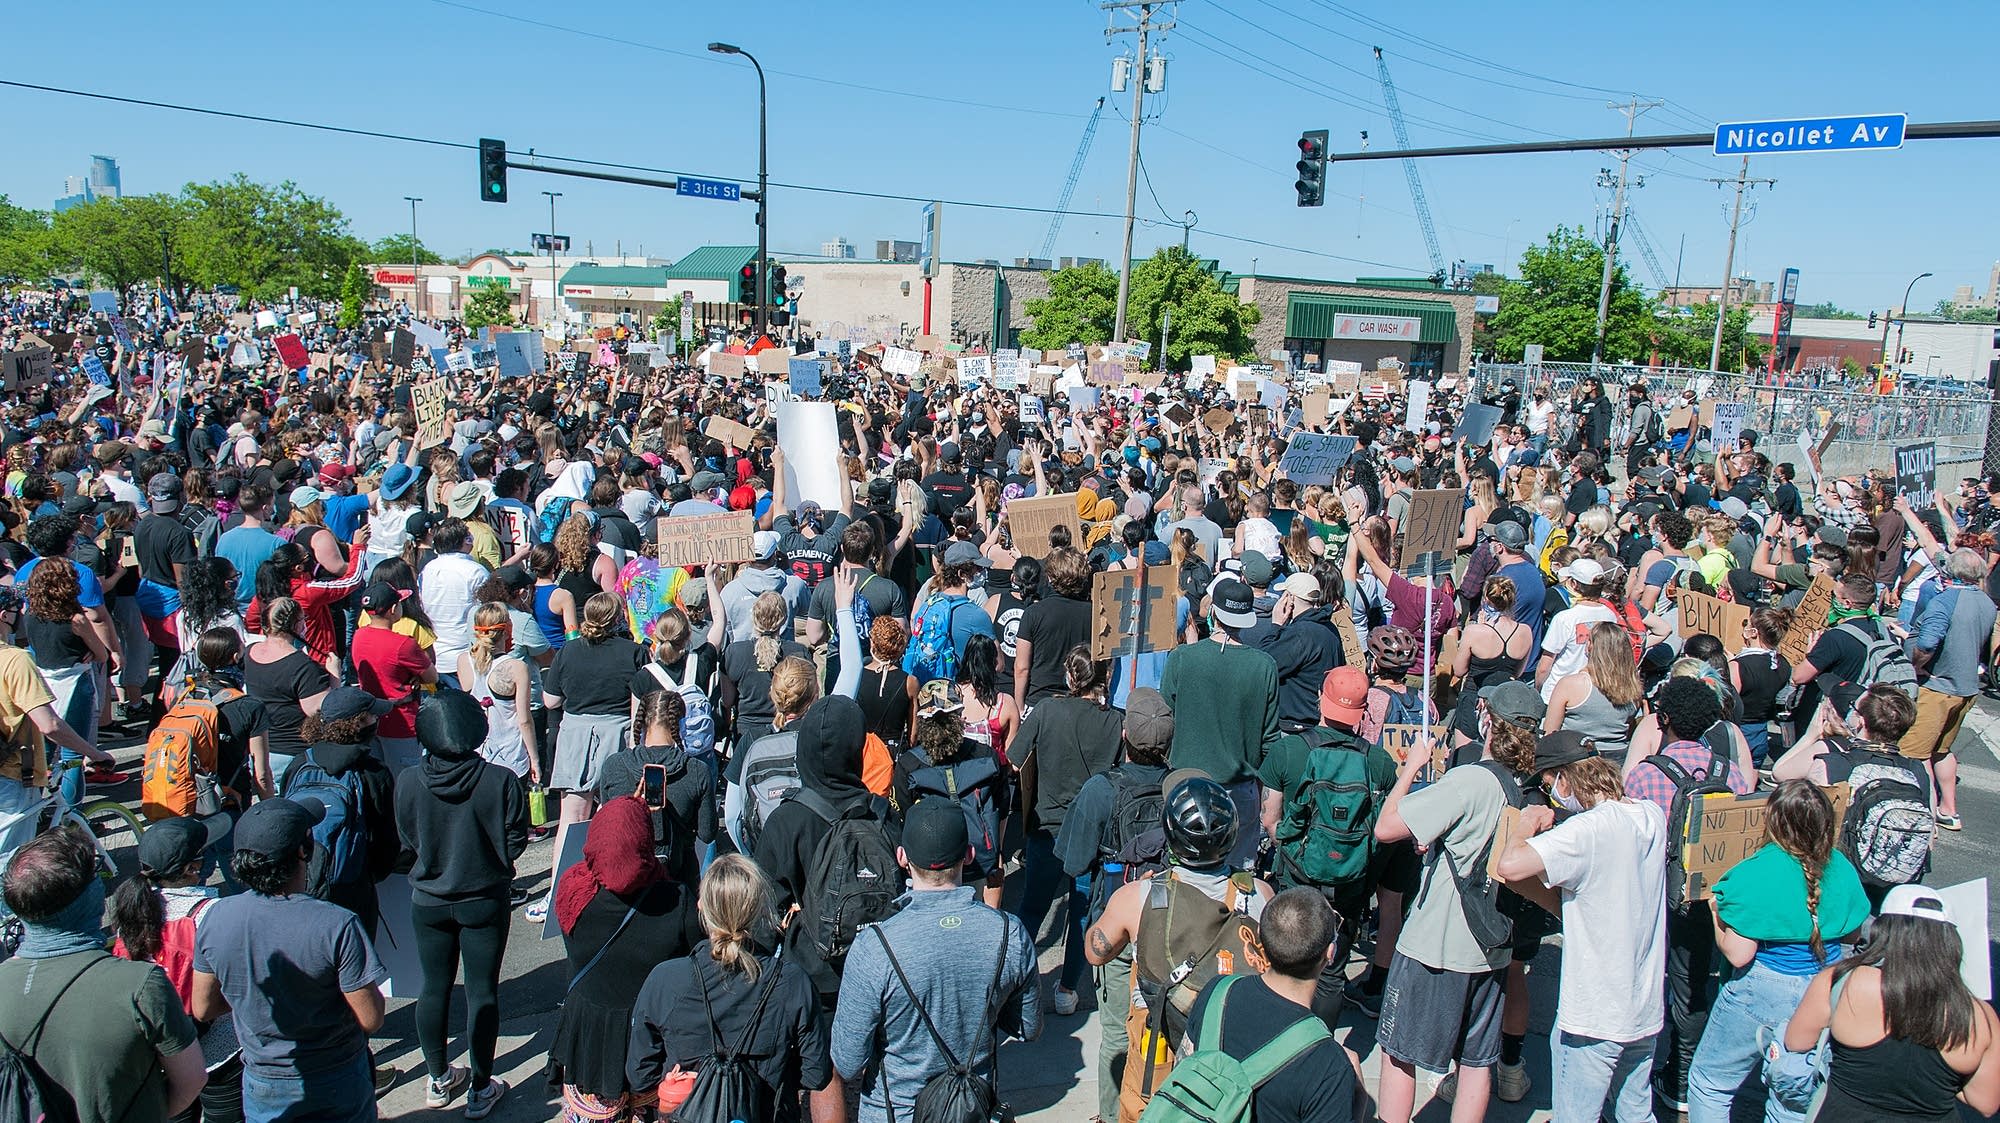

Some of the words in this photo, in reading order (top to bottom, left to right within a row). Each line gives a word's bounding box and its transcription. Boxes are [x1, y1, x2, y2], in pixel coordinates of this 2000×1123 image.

[1726, 125, 1834, 149] Nicollet
[1850, 122, 1890, 143] Av
[680, 181, 688, 192] E
[694, 182, 718, 196] 31st
[723, 186, 737, 198] St
[1359, 322, 1375, 333] CAR
[1378, 324, 1398, 334] WASH
[15, 355, 33, 381] NO
[413, 381, 445, 408] BLACK
[416, 398, 445, 424] LIVES
[1721, 421, 1732, 433] THE
[1292, 434, 1312, 452] We
[1899, 447, 1934, 477] JUSTICE
[1408, 494, 1464, 550] BLM
[660, 540, 689, 566] BLACK
[715, 536, 755, 561] MATTER
[786, 549, 834, 563] CLEMENTE
[1812, 576, 1825, 597] OF
[1683, 594, 1721, 638] BLM
[1792, 605, 1825, 654] PEOPLE
[1706, 810, 1726, 830] NO
[1703, 840, 1726, 865] NO
